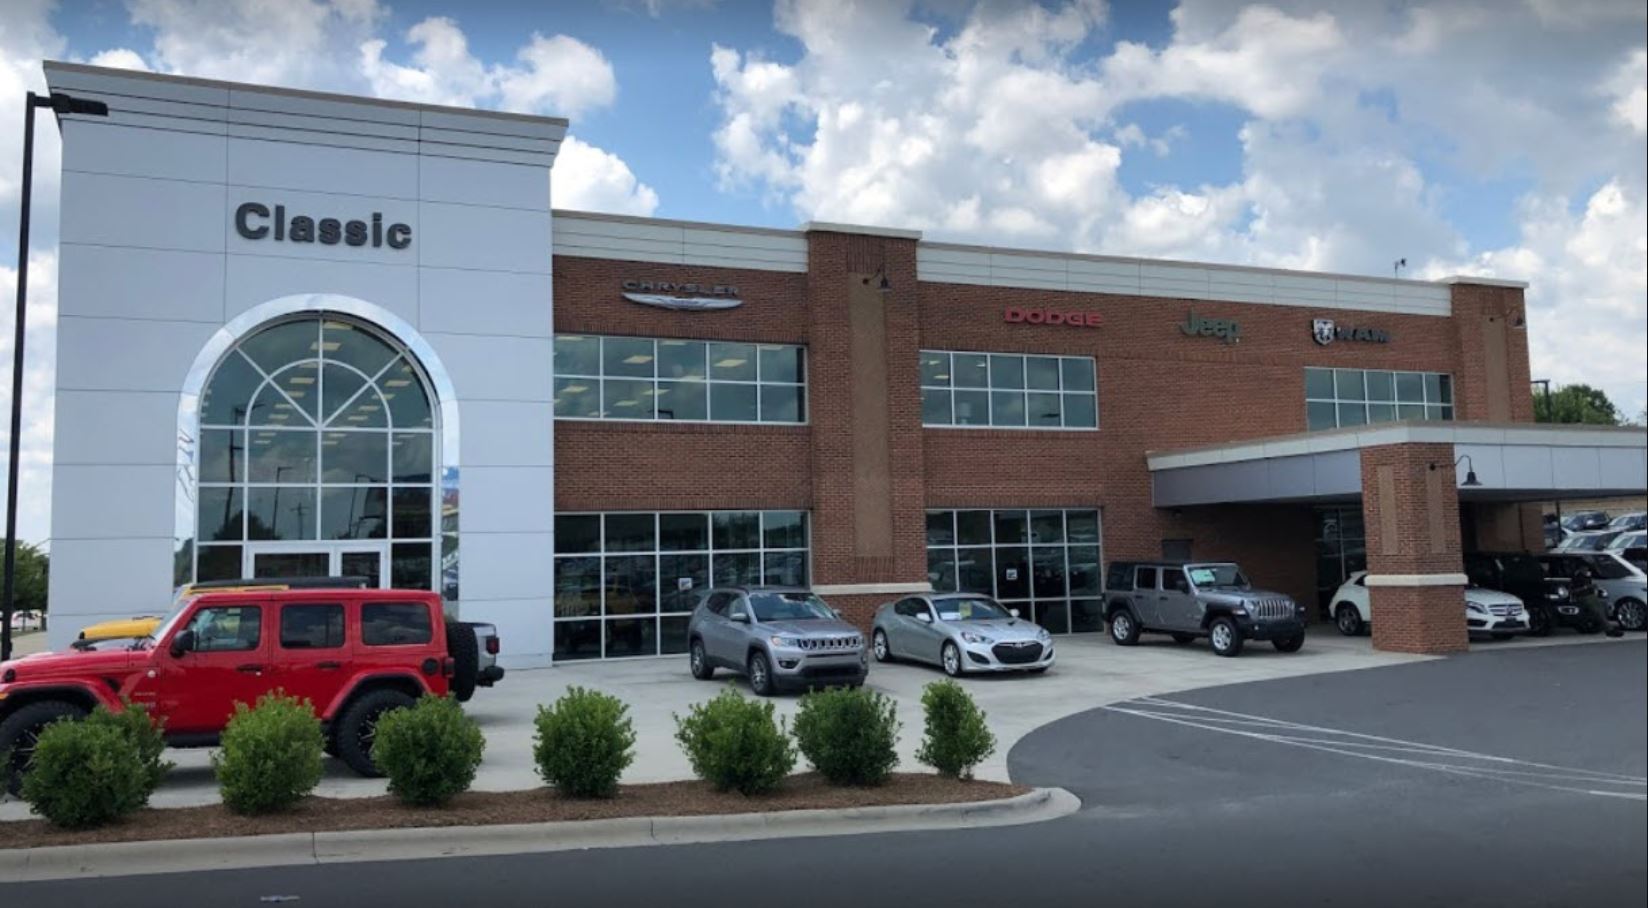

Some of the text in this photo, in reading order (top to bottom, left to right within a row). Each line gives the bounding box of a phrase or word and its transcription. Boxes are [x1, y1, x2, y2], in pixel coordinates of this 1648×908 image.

[235, 202, 412, 249] Classic
[622, 279, 739, 294] CHRYSLER
[1004, 306, 1104, 327] DODGE
[1180, 307, 1241, 344] Jeep
